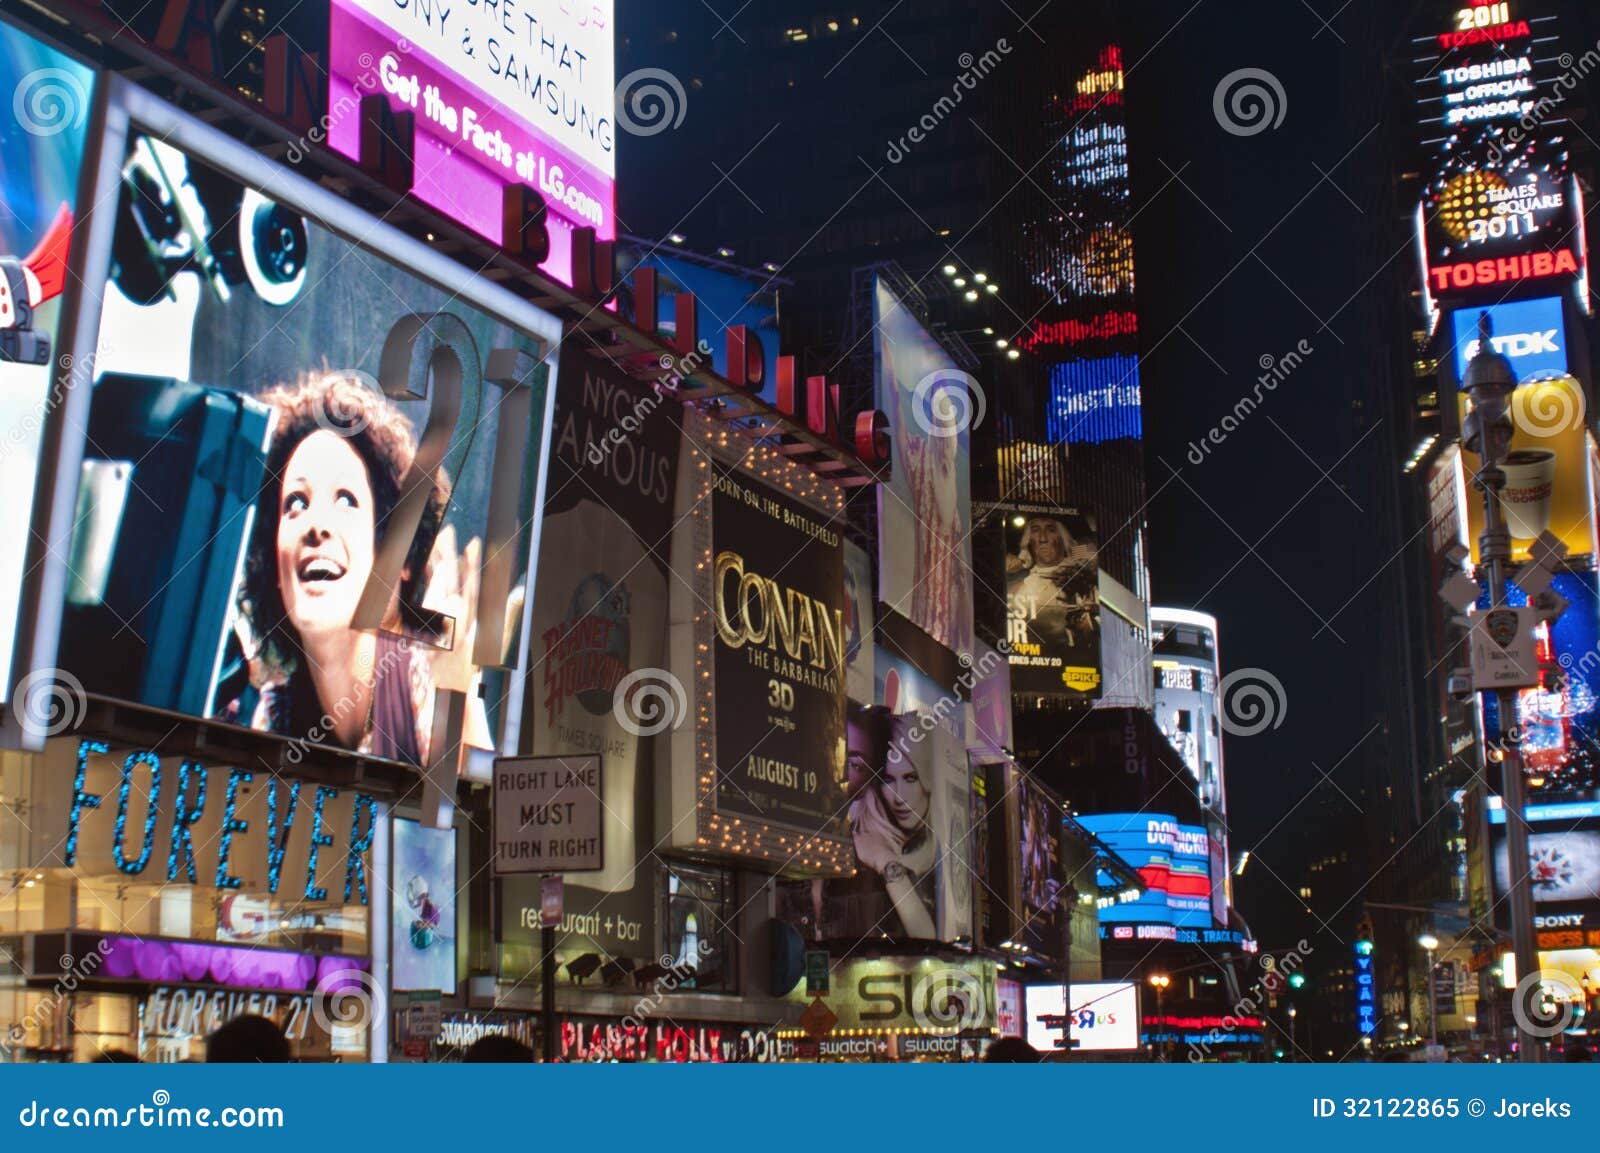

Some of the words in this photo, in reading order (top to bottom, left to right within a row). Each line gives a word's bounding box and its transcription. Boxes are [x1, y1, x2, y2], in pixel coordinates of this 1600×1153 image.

[1457, 2, 1509, 30] 2011
[524, 12, 587, 83] THAT
[1439, 20, 1530, 48] TOSHIBA
[1443, 57, 1531, 84] TOSHIBA
[487, 38, 612, 152] SAMSUNG
[1465, 78, 1533, 99] OFFICIAL
[1448, 99, 1520, 122] SPONSOR
[380, 55, 420, 108] Get
[423, 85, 458, 133] the
[461, 106, 513, 168] Facts
[515, 152, 537, 182] at
[538, 157, 604, 226] LG.com
[1485, 183, 1537, 202] TIMES
[1495, 194, 1563, 216] SQUARE
[1468, 213, 1539, 241] 2011
[1431, 249, 1578, 290] TOSHIBA
[502, 182, 891, 470] BUILDING
[1491, 329, 1559, 357] TDK
[556, 408, 670, 502] AMOUS
[711, 472, 740, 500] BORN
[744, 490, 759, 508] ON
[763, 499, 780, 519] THE
[784, 509, 839, 548] BATTLEFIELD
[714, 551, 844, 673] CONAN
[748, 647, 769, 669] THE
[774, 656, 838, 694] BARBARIAN
[1051, 657, 1062, 666] 20
[1062, 672, 1100, 683] SPIKE
[768, 679, 795, 712] 3D
[500, 772, 547, 791] RIGHT
[555, 769, 597, 788] LANE
[747, 756, 799, 790] AUGUST
[804, 771, 817, 794] 19
[64, 740, 378, 905] FOREVER
[520, 803, 575, 826] MUST
[500, 841, 542, 860] TURN
[550, 838, 597, 857] RIGHT
[617, 914, 642, 941] bar
[1534, 914, 1585, 928] SONY
[284, 996, 313, 1039] 21
[561, 1022, 648, 1062] PLANET
[820, 1036, 877, 1055] swatch
